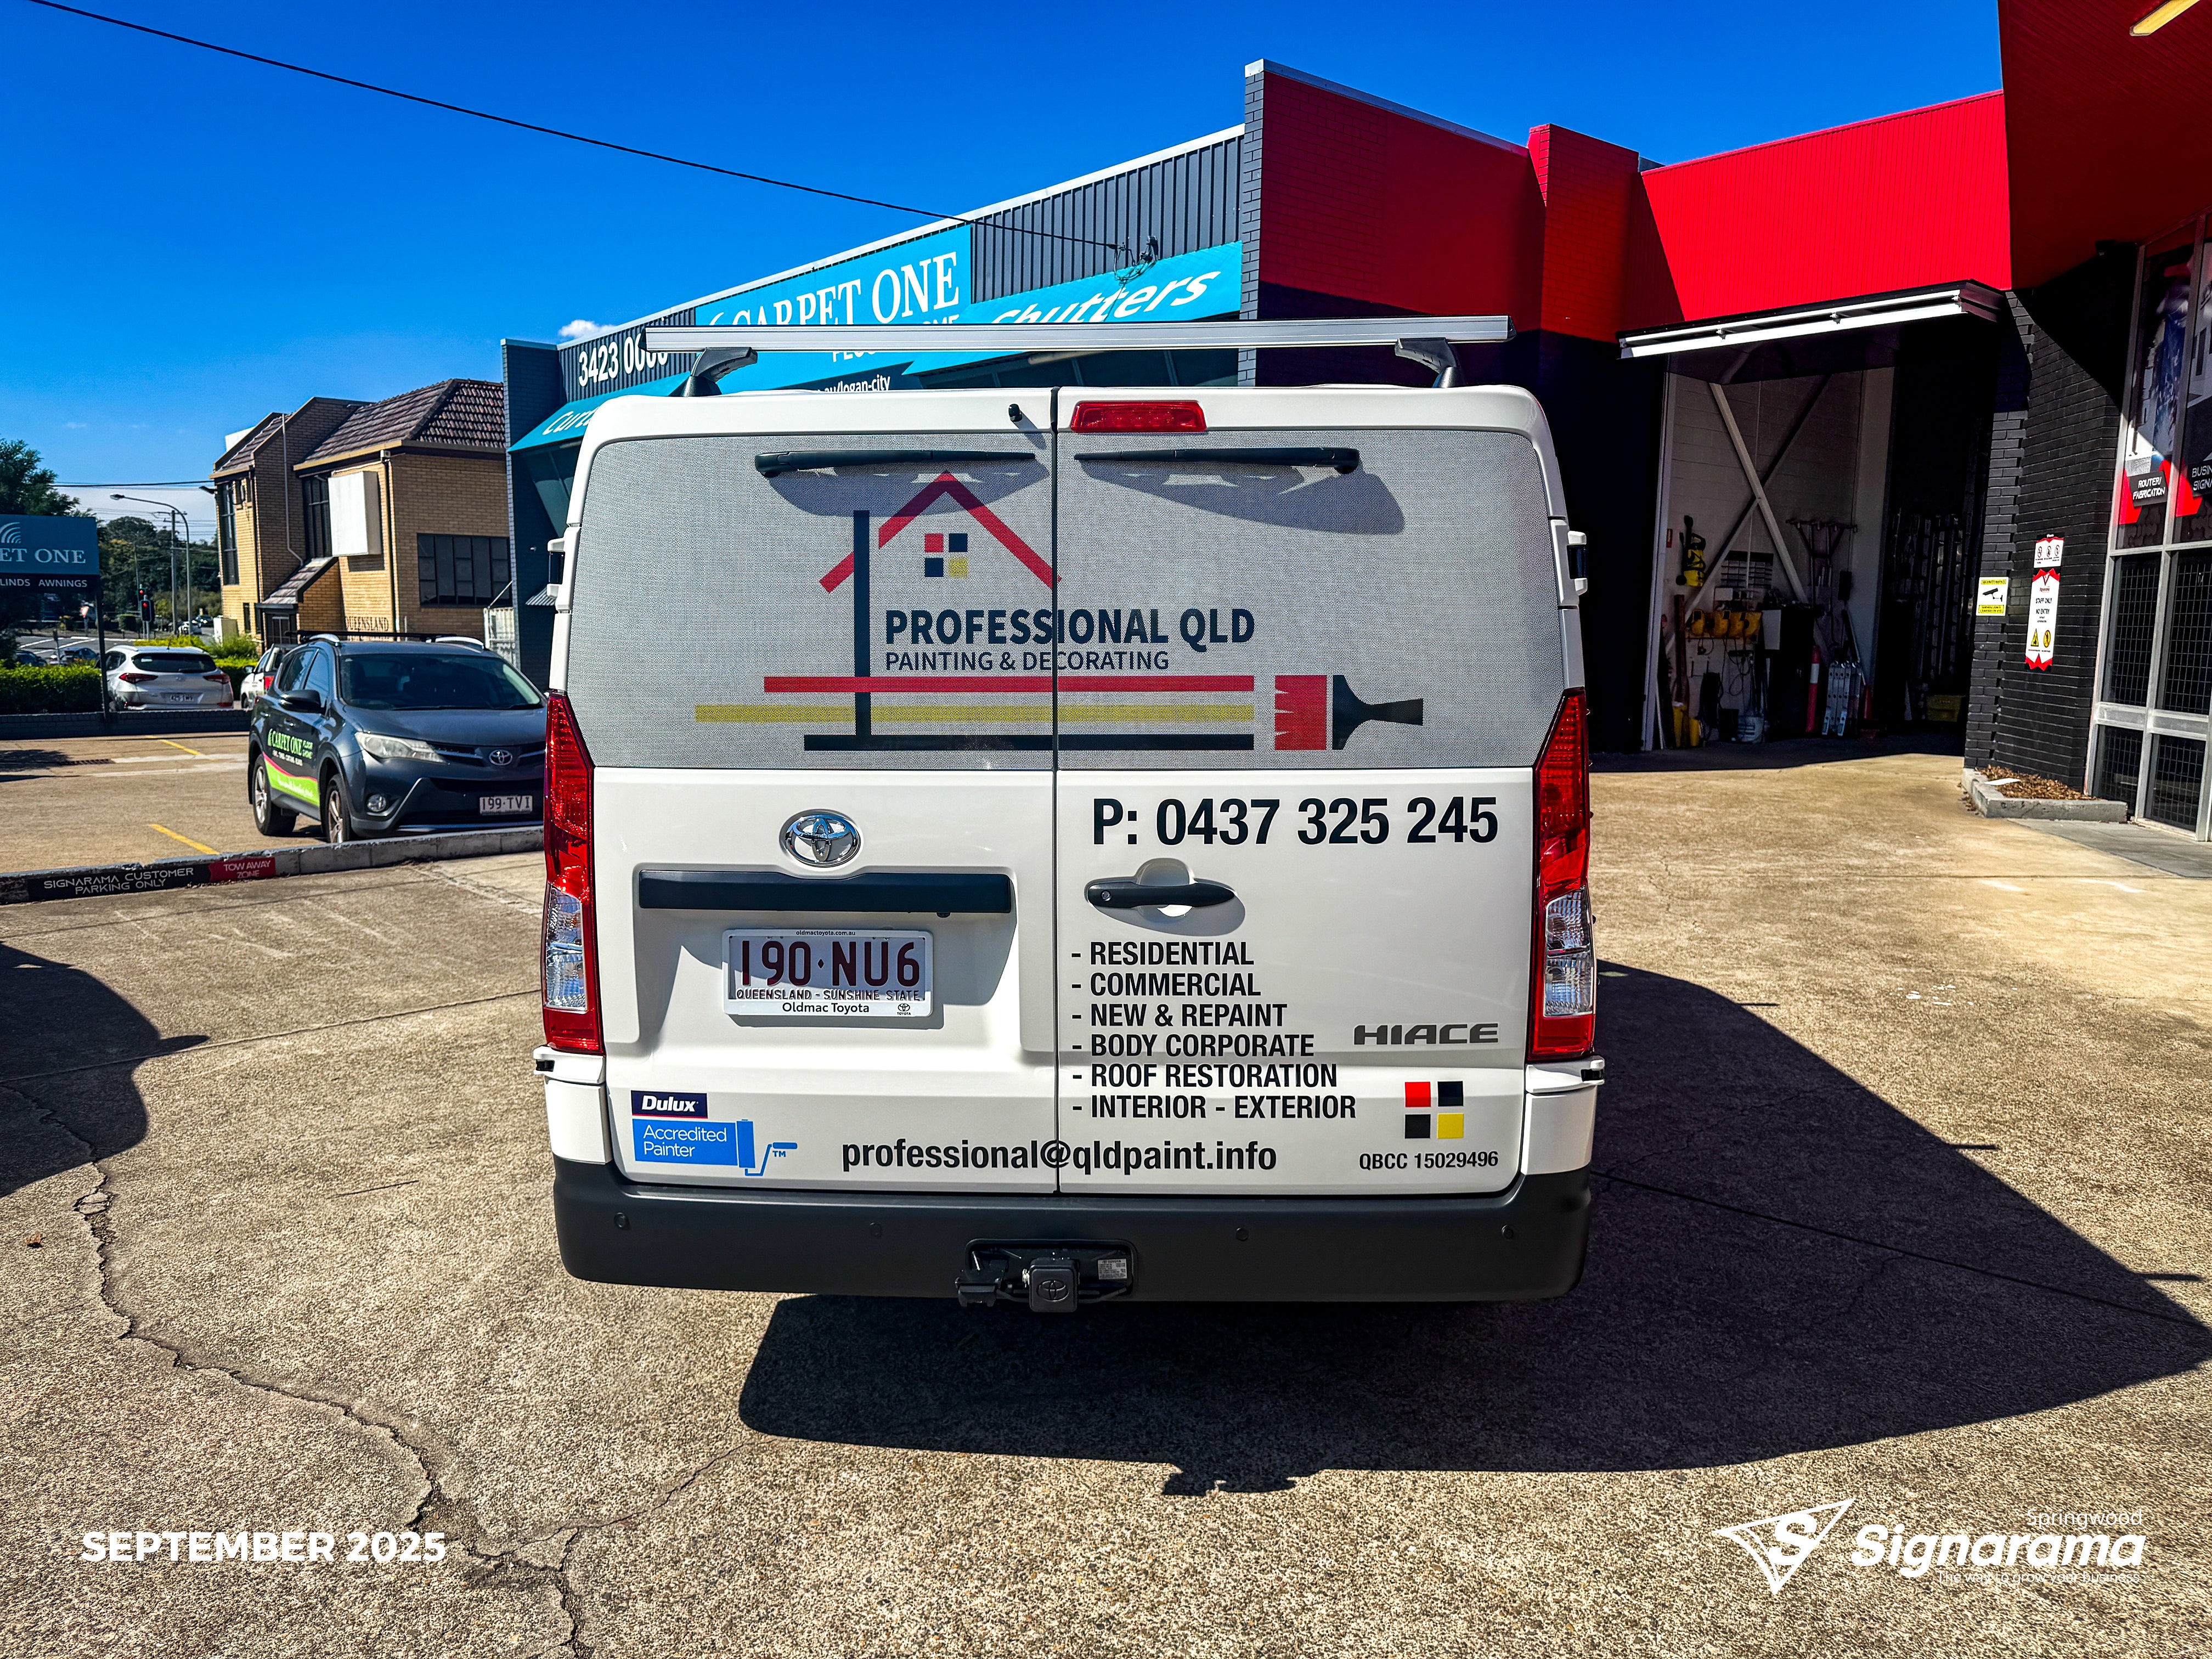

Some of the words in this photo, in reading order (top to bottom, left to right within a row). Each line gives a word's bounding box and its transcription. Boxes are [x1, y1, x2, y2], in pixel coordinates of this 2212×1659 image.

[872, 251, 959, 324] ONE
[579, 341, 619, 387] 3423
[2138, 476, 2162, 489] ROUTER/
[2132, 487, 2166, 500] FABRICATION
[35, 549, 86, 563] ONE
[38, 579, 88, 588] AWNINGS
[885, 608, 1169, 645] PROFESSIONAL
[1180, 608, 1255, 653] QLD
[886, 652, 993, 670] PAINTING
[1001, 651, 1015, 670] &
[1023, 651, 1169, 670] DECORATING
[290, 736, 303, 756] ONE
[1093, 798, 1138, 845] P:
[1156, 798, 1280, 846] 0437
[1297, 798, 1390, 845] 325
[1407, 796, 1499, 844] 245
[223, 861, 245, 872] TOW
[246, 860, 272, 870] AWAY
[236, 869, 260, 878] ZONE
[44, 873, 118, 889] SIGNARAMA
[125, 867, 194, 880] CUSTOMER
[75, 880, 131, 895] PARKING
[135, 878, 167, 889] ONLY
[1091, 941, 1255, 966] RESIDENTIAL
[1090, 973, 1262, 996] COMMERCIAL
[736, 988, 811, 1001] QUEENSLAND
[823, 989, 880, 1001] SUNSHINE
[886, 989, 920, 1001] STATE
[782, 1002, 829, 1013] Oldmac
[832, 1002, 870, 1015] Toyota
[1091, 1004, 1148, 1027] NEW
[1155, 1004, 1174, 1027] &
[1182, 1003, 1288, 1027] REPAINT
[1354, 1023, 1499, 1045] HIACE
[1091, 1034, 1158, 1057] BODY
[1166, 1034, 1314, 1057] CORPORATE
[1092, 1064, 1158, 1088] ROOF
[1166, 1064, 1338, 1088] RESTORATION
[642, 1095, 696, 1112] Dulux
[1092, 1095, 1207, 1119] INTERIOR
[1235, 1096, 1356, 1119] EXTERIOR
[643, 1125, 727, 1142] Accredited
[644, 1142, 696, 1157] Painter
[842, 1139, 1278, 1172] professional@qldpaint.info
[1359, 1153, 1408, 1170] QBCC
[1414, 1151, 1499, 1169] 15029496
